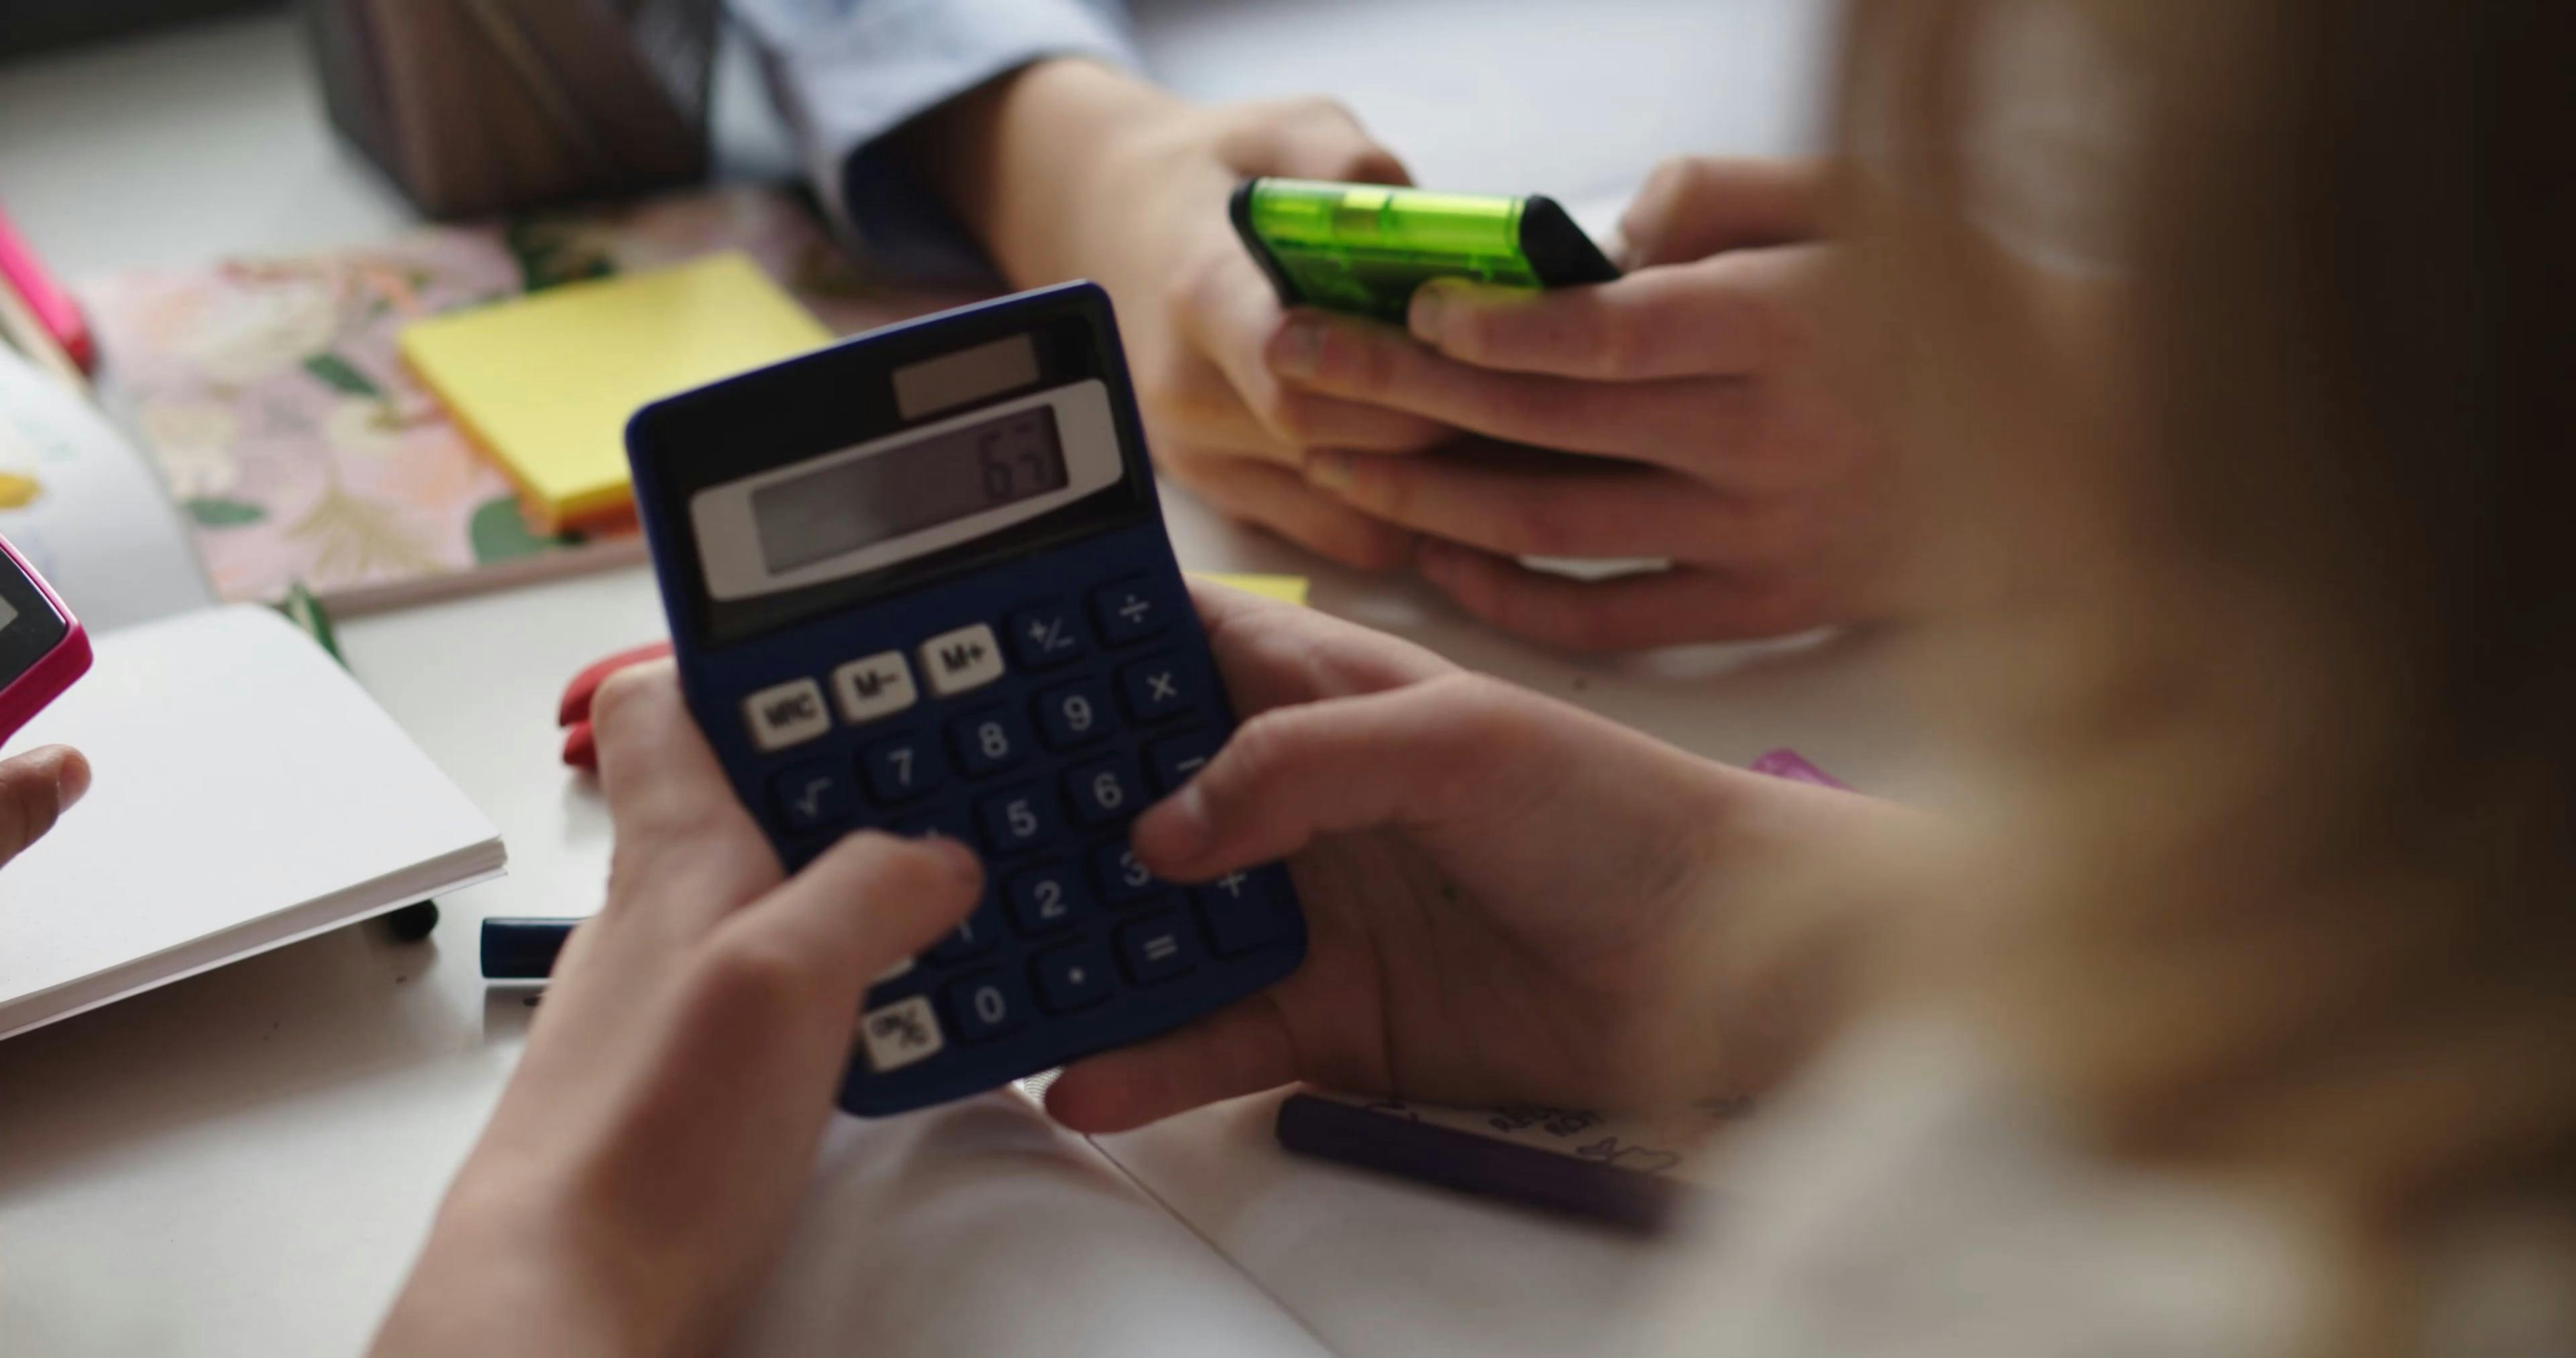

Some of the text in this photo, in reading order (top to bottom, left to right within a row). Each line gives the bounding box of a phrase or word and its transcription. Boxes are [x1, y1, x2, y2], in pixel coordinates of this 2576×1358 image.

[941, 644, 986, 673] M+
[1063, 695, 1092, 731] 9
[979, 722, 1008, 758] 8
[888, 748, 914, 785] 7
[1093, 773, 1123, 809] 6
[1006, 799, 1038, 838] 5
[1034, 880, 1065, 919] 2
[974, 986, 1005, 1024] 0
